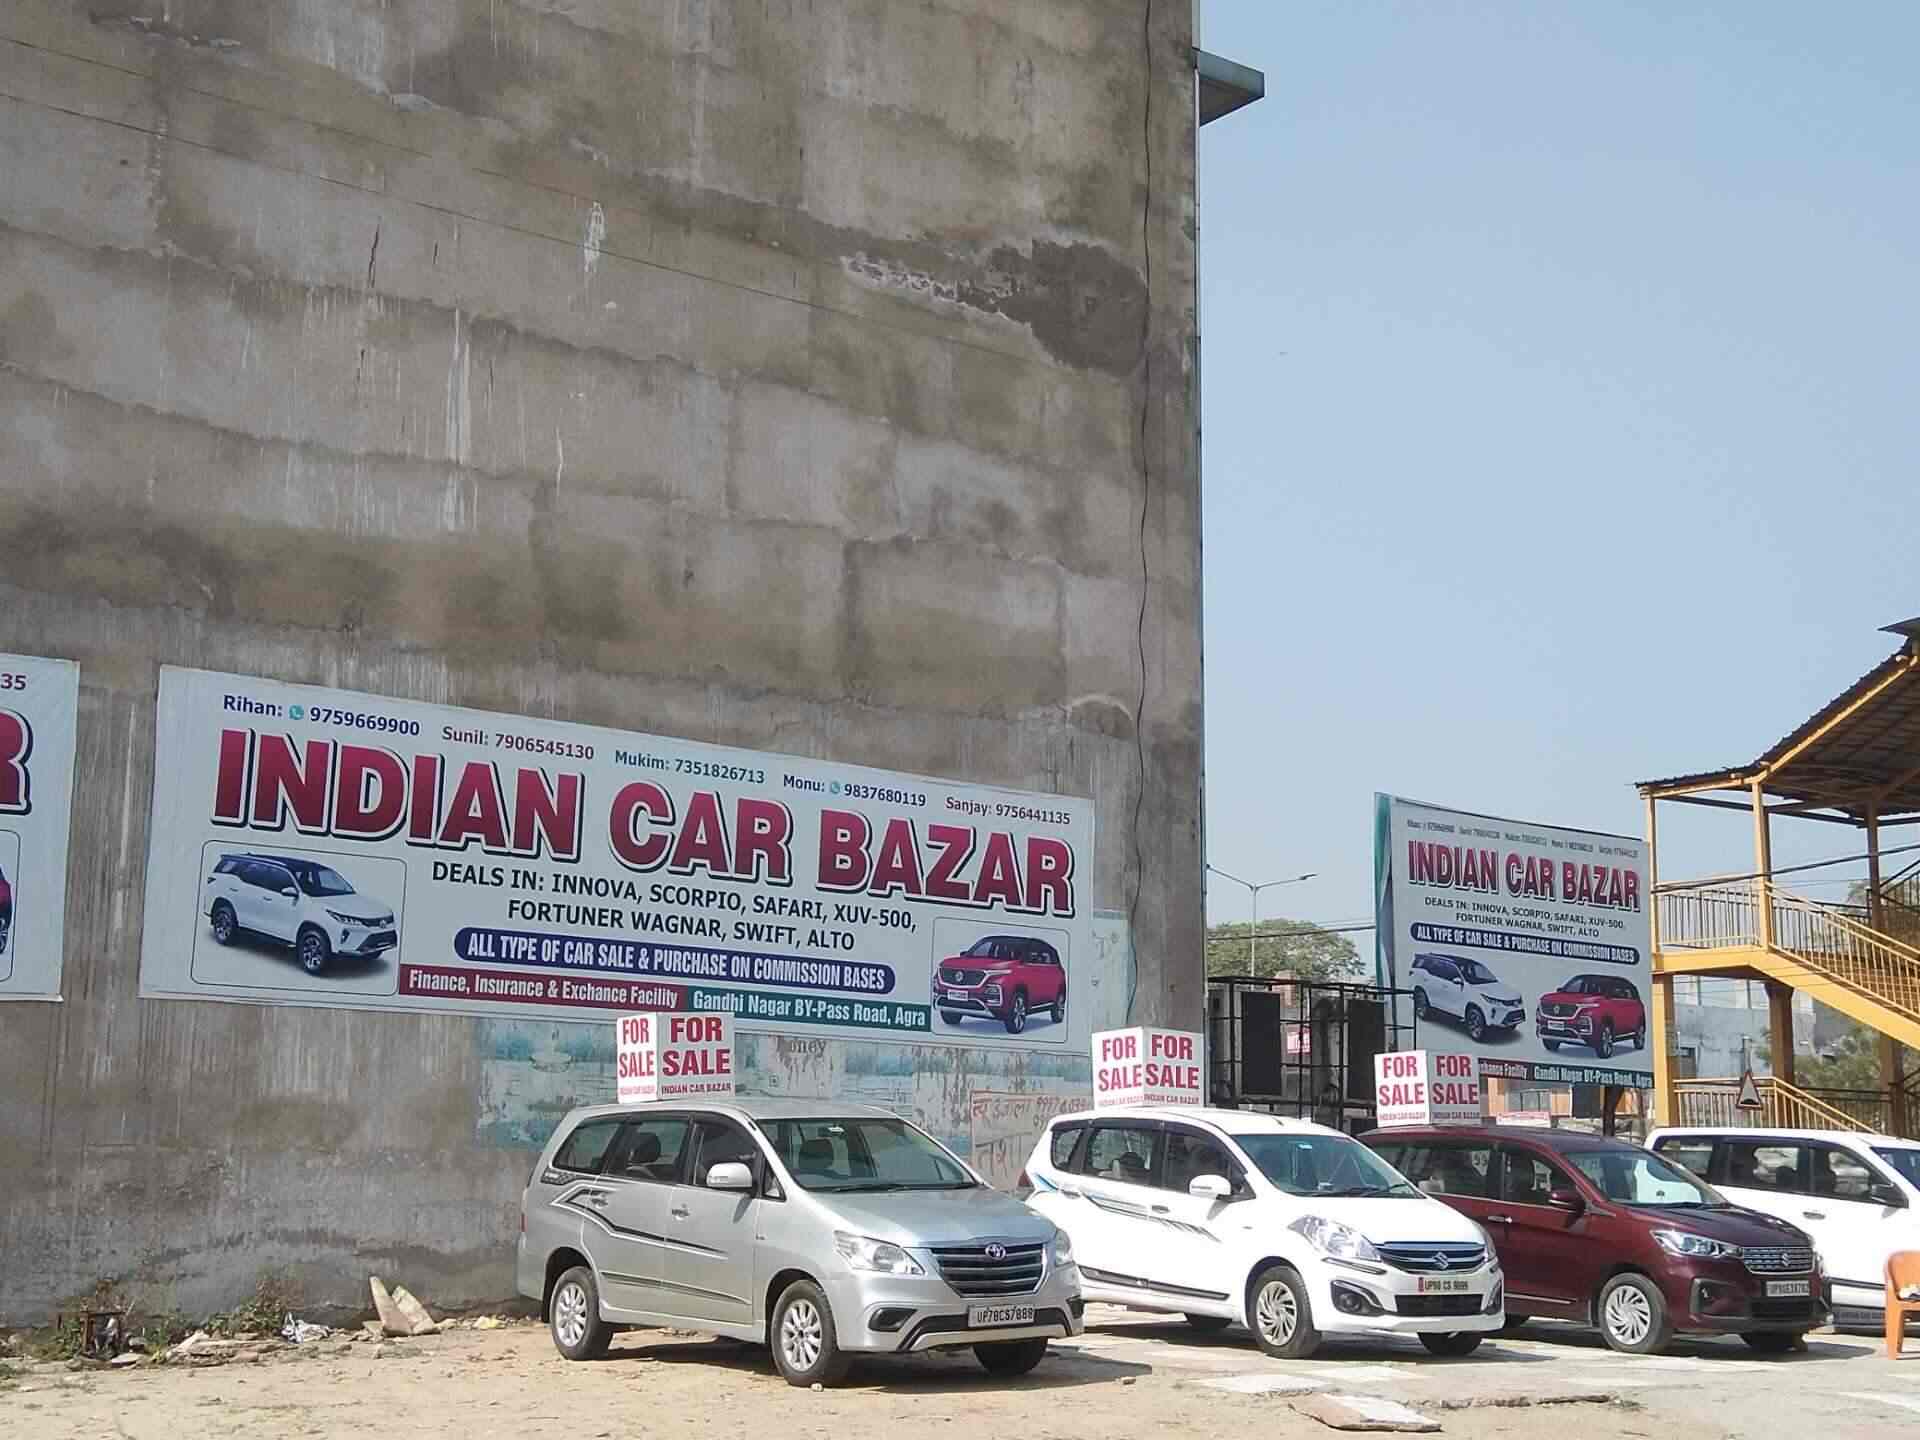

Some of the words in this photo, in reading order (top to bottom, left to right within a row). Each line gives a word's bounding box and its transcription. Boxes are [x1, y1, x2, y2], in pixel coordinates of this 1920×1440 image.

[223, 695, 283, 717] Rihan:
[310, 707, 420, 735] 9759669900
[442, 726, 488, 746] Sunil:
[495, 734, 594, 760] 7906545130
[615, 750, 669, 770] Mukim:
[675, 759, 765, 783] 7351826713
[783, 774, 825, 792] Monu:
[844, 783, 926, 806] 9837680119
[210, 727, 586, 864] INDIAN
[608, 778, 794, 888] CAR
[816, 805, 1076, 919] BAZAR
[946, 797, 992, 816] Sanjay:
[995, 802, 1070, 824] 9756441135
[1408, 839, 1500, 895] INDIAN
[1504, 852, 1557, 902] CAR
[1562, 860, 1641, 913] BAZAR
[432, 861, 505, 886] DEALS
[511, 869, 545, 891] IN:
[551, 873, 643, 905] INNOVA,
[650, 883, 747, 915] SCORPIO,
[753, 895, 828, 924] SAFARI,
[833, 903, 917, 933] XUV-500,
[1424, 896, 1454, 907] DEALS
[508, 899, 625, 929] FORTUNER
[631, 911, 727, 942] WAGNAR,
[733, 921, 801, 949] SWIFT,
[807, 930, 855, 951] ALTO
[1456, 912, 1502, 925] FORTUNER
[1578, 929, 1599, 938] ALTO
[1417, 925, 1432, 940] ALL
[1433, 927, 1453, 942] TYPE
[1454, 929, 1464, 943] OF
[1465, 930, 1481, 945] CAR
[1483, 932, 1502, 947] SALE
[1511, 936, 1550, 953] PURCHASE
[467, 932, 495, 958] ALL
[500, 935, 537, 962] TYPE
[541, 938, 560, 963] OF
[564, 940, 595, 966] CAR
[598, 944, 634, 969] SALE
[638, 948, 650, 969] &
[653, 949, 727, 977] PURCHASE
[731, 957, 750, 979] ON
[754, 958, 841, 986] COMMISSION
[844, 967, 885, 990] BASES
[409, 969, 471, 993] Finance,
[474, 973, 544, 997] Insurance
[547, 979, 558, 998] &
[562, 981, 627, 1003] Exchance
[631, 986, 678, 1009] Facility
[693, 990, 743, 1012] Gandhi
[748, 996, 791, 1018] Nagar
[795, 999, 850, 1021] BY-Pass
[854, 1003, 891, 1025] Road,
[895, 1007, 926, 1026] Agra
[622, 1018, 649, 1045] FOR
[670, 1017, 722, 1043] FOR
[1102, 1035, 1136, 1061] FOR
[1152, 1034, 1192, 1060] FOR
[619, 1050, 655, 1078] SALE
[662, 1049, 731, 1076] SALE
[1145, 1063, 1200, 1089] SALE
[1383, 1056, 1417, 1078] FOR
[1436, 1055, 1471, 1077] FOR
[1534, 1066, 1559, 1081] Gandhi
[661, 1084, 687, 1095] INDIAN
[689, 1083, 705, 1093] CAR
[706, 1082, 731, 1092] BAZAR
[1098, 1064, 1142, 1091] SALE
[1379, 1083, 1424, 1106] SALE
[1432, 1083, 1479, 1105] SALE
